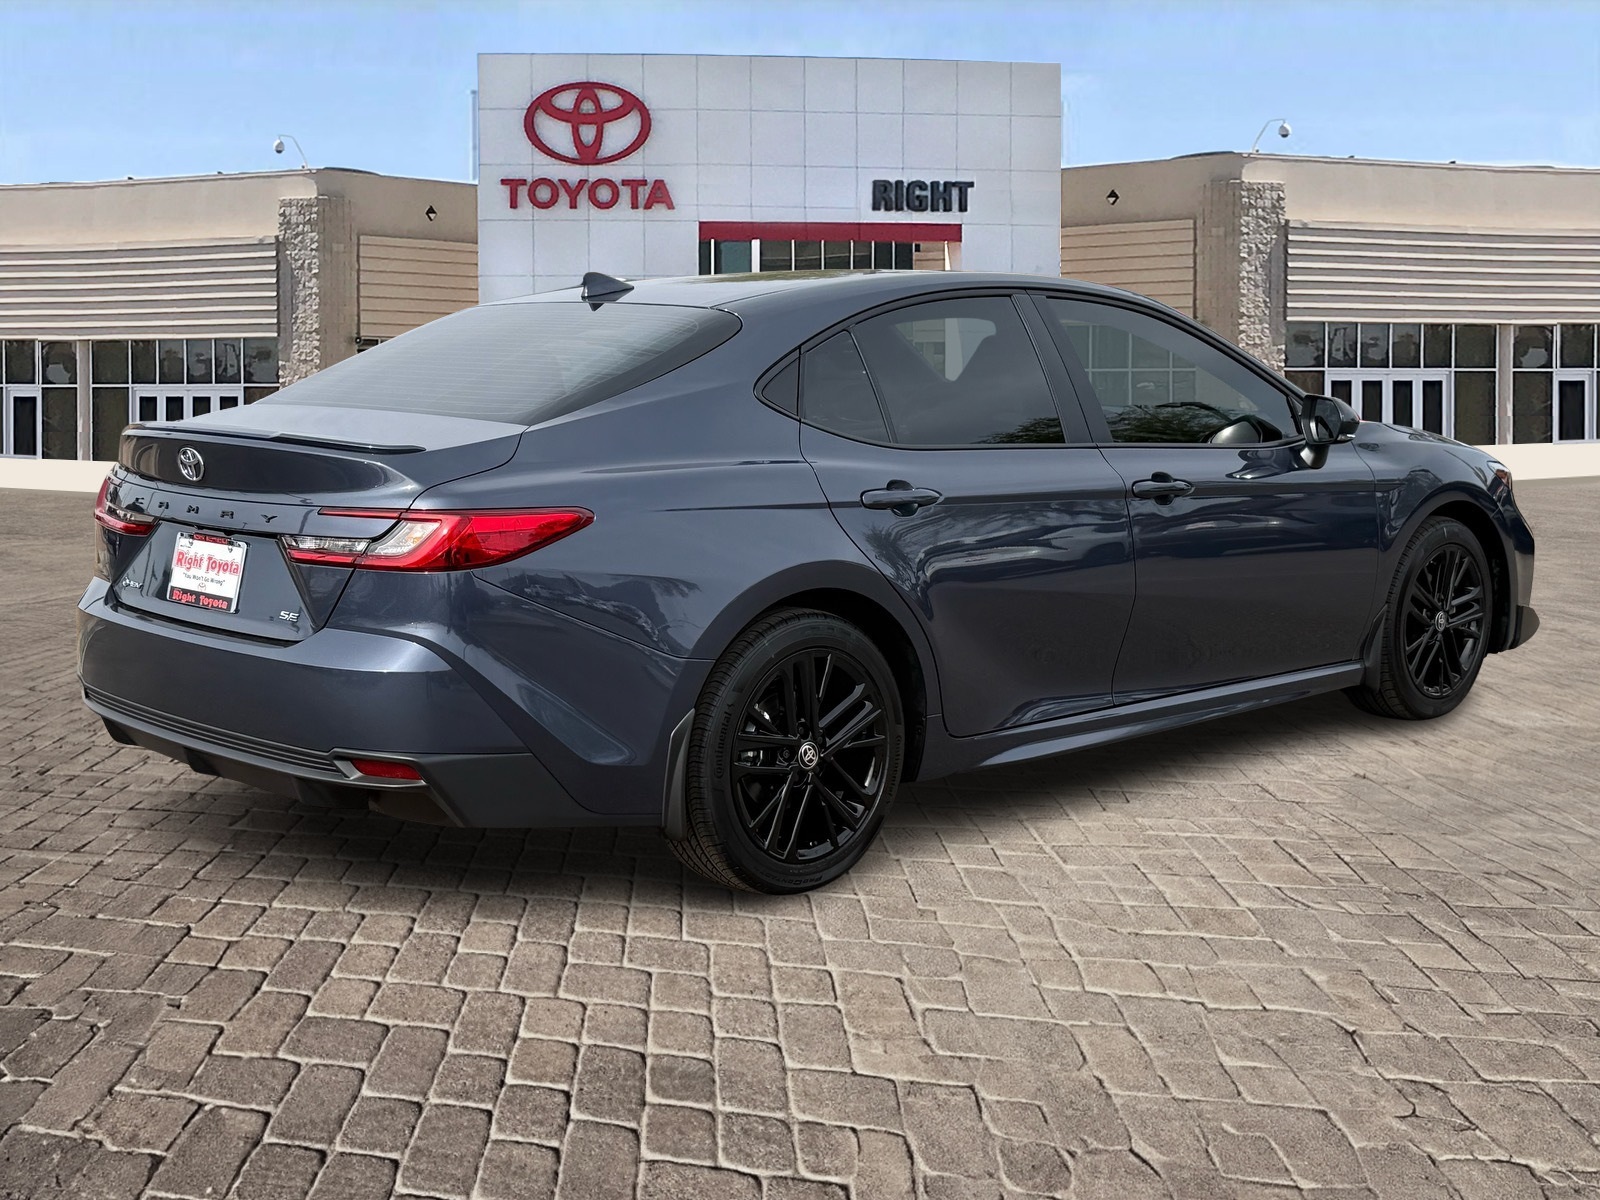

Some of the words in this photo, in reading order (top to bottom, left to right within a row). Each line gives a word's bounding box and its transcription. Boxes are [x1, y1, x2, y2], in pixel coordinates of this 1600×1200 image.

[500, 178, 676, 211] TOYOTA
[872, 179, 975, 213] RIGHT
[134, 496, 278, 523] CAMRY
[176, 551, 204, 571] Right
[206, 556, 240, 575] Toyota
[172, 589, 196, 603] Right
[200, 595, 228, 609] Toyota
[279, 610, 300, 622] SE
[713, 711, 732, 779] Continental
